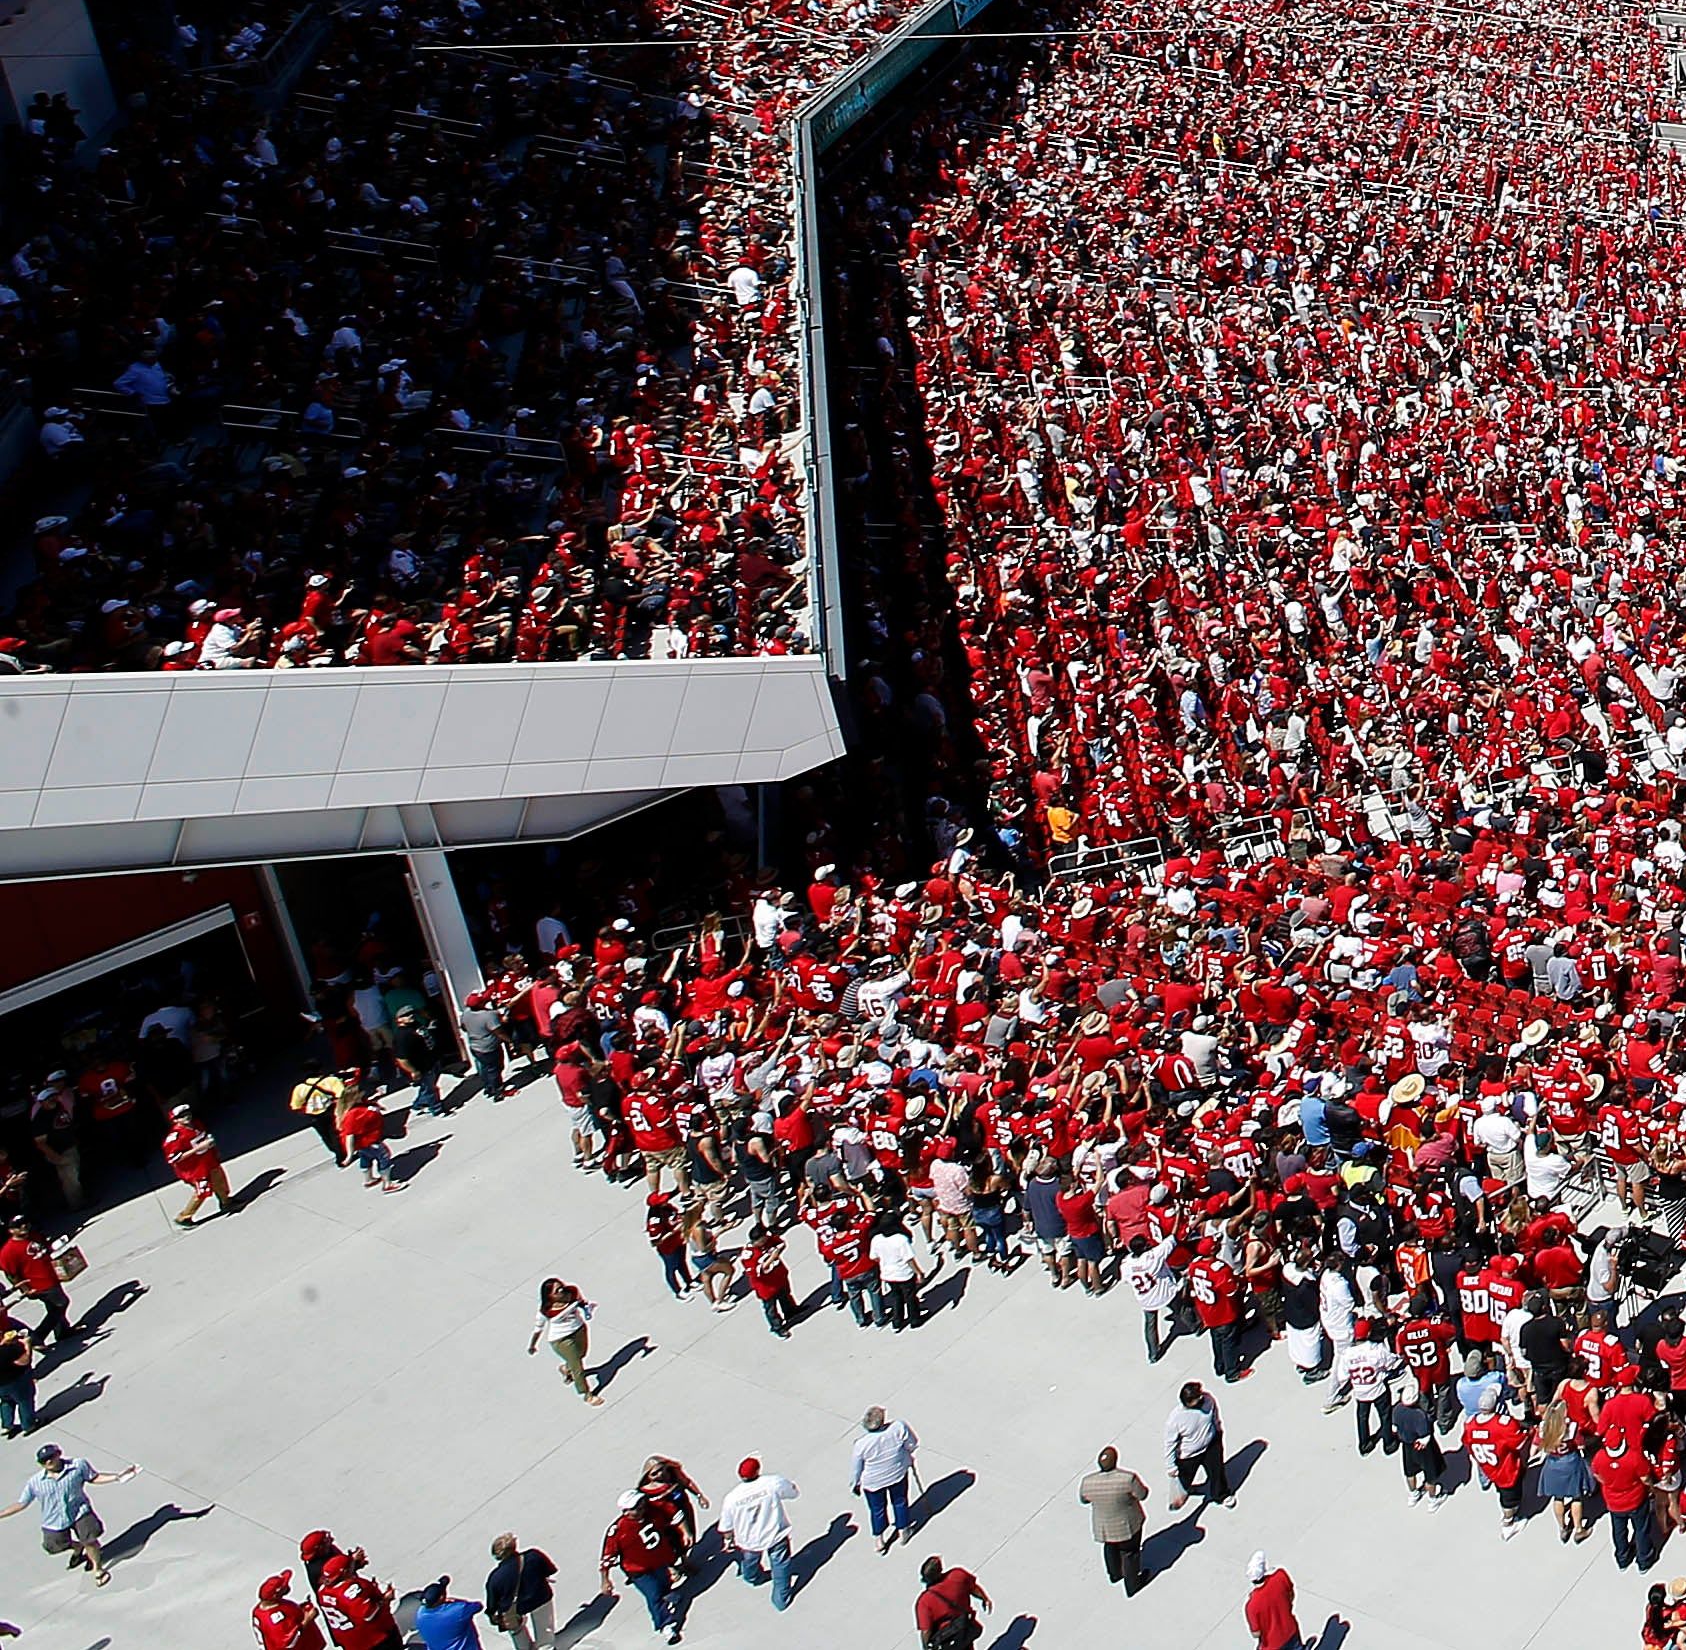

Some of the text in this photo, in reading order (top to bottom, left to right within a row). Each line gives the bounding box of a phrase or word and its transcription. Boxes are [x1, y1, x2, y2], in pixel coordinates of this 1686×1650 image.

[1592, 958, 1606, 979] 11
[1603, 1114, 1621, 1148] 21
[1460, 1290, 1489, 1313] 80
[1489, 1300, 1507, 1323] 16
[1407, 1328, 1429, 1340] WILLIS
[1404, 1342, 1437, 1367] 52
[1350, 1367, 1377, 1385] 52
[1472, 1443, 1498, 1466] 85
[640, 1523, 660, 1550] 5
